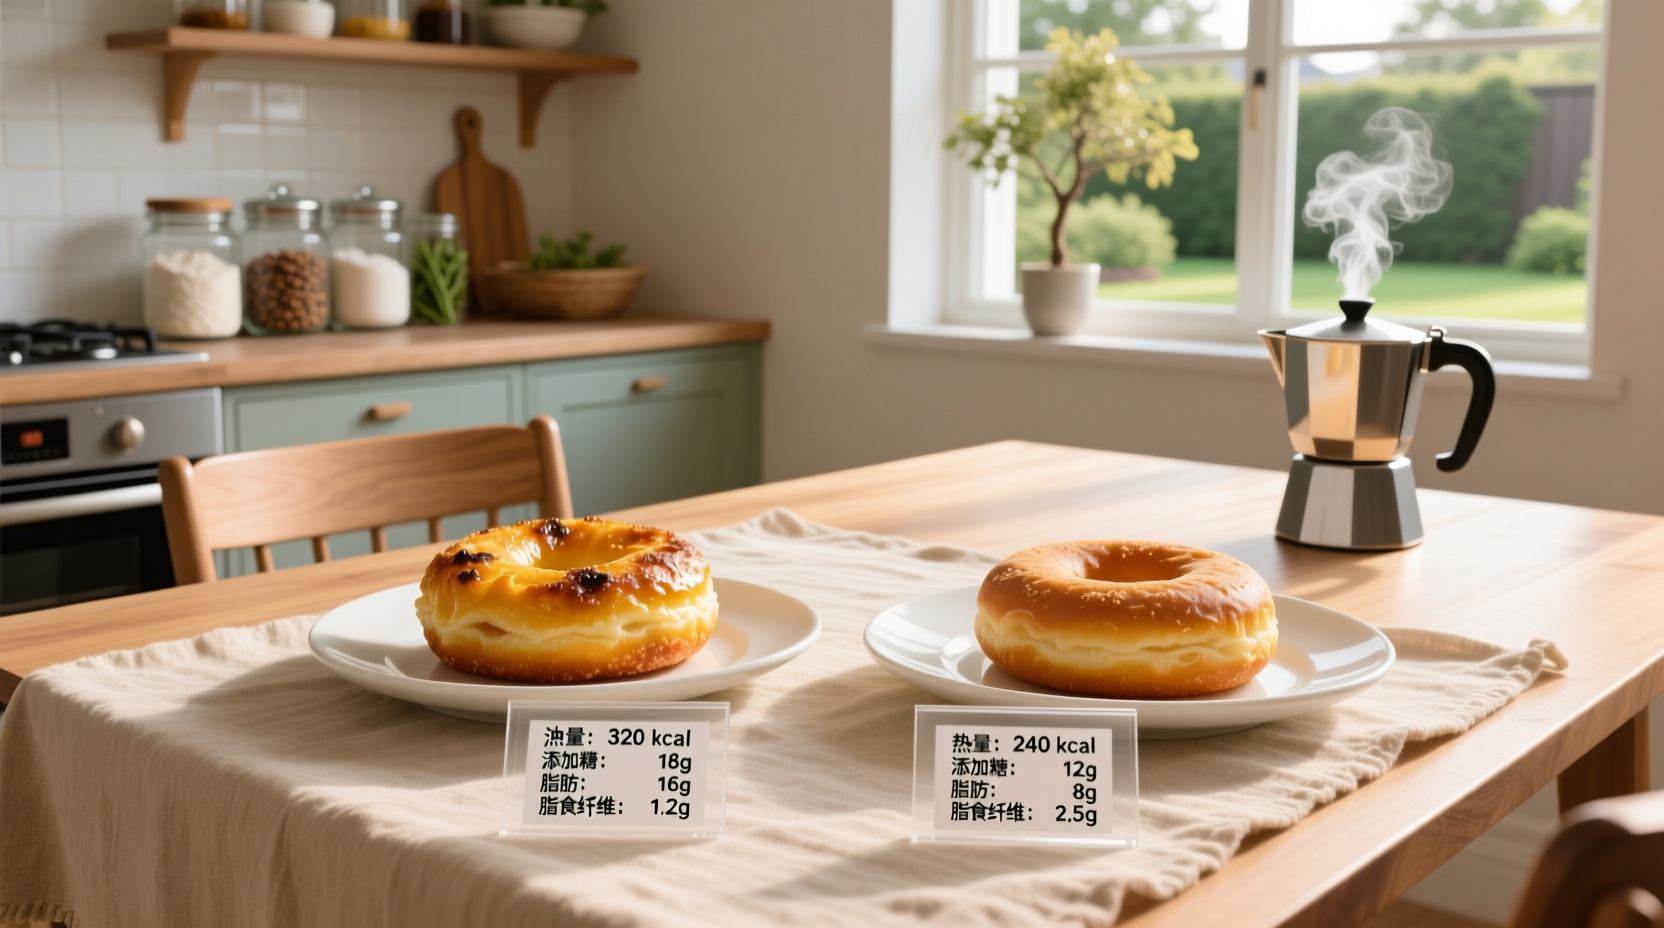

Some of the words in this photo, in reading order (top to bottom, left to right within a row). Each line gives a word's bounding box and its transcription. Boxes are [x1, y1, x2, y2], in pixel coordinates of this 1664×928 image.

[607, 728, 645, 746] 320
[651, 728, 691, 747] kcal
[1012, 735, 1051, 753] 240
[1056, 736, 1096, 754] kcal
[658, 752, 692, 775] 18g
[1063, 760, 1097, 783] 12g
[657, 775, 691, 797] 16g
[1072, 782, 1097, 805] 8g
[650, 796, 690, 819] 1.2g
[1055, 804, 1097, 827] 2.5g
